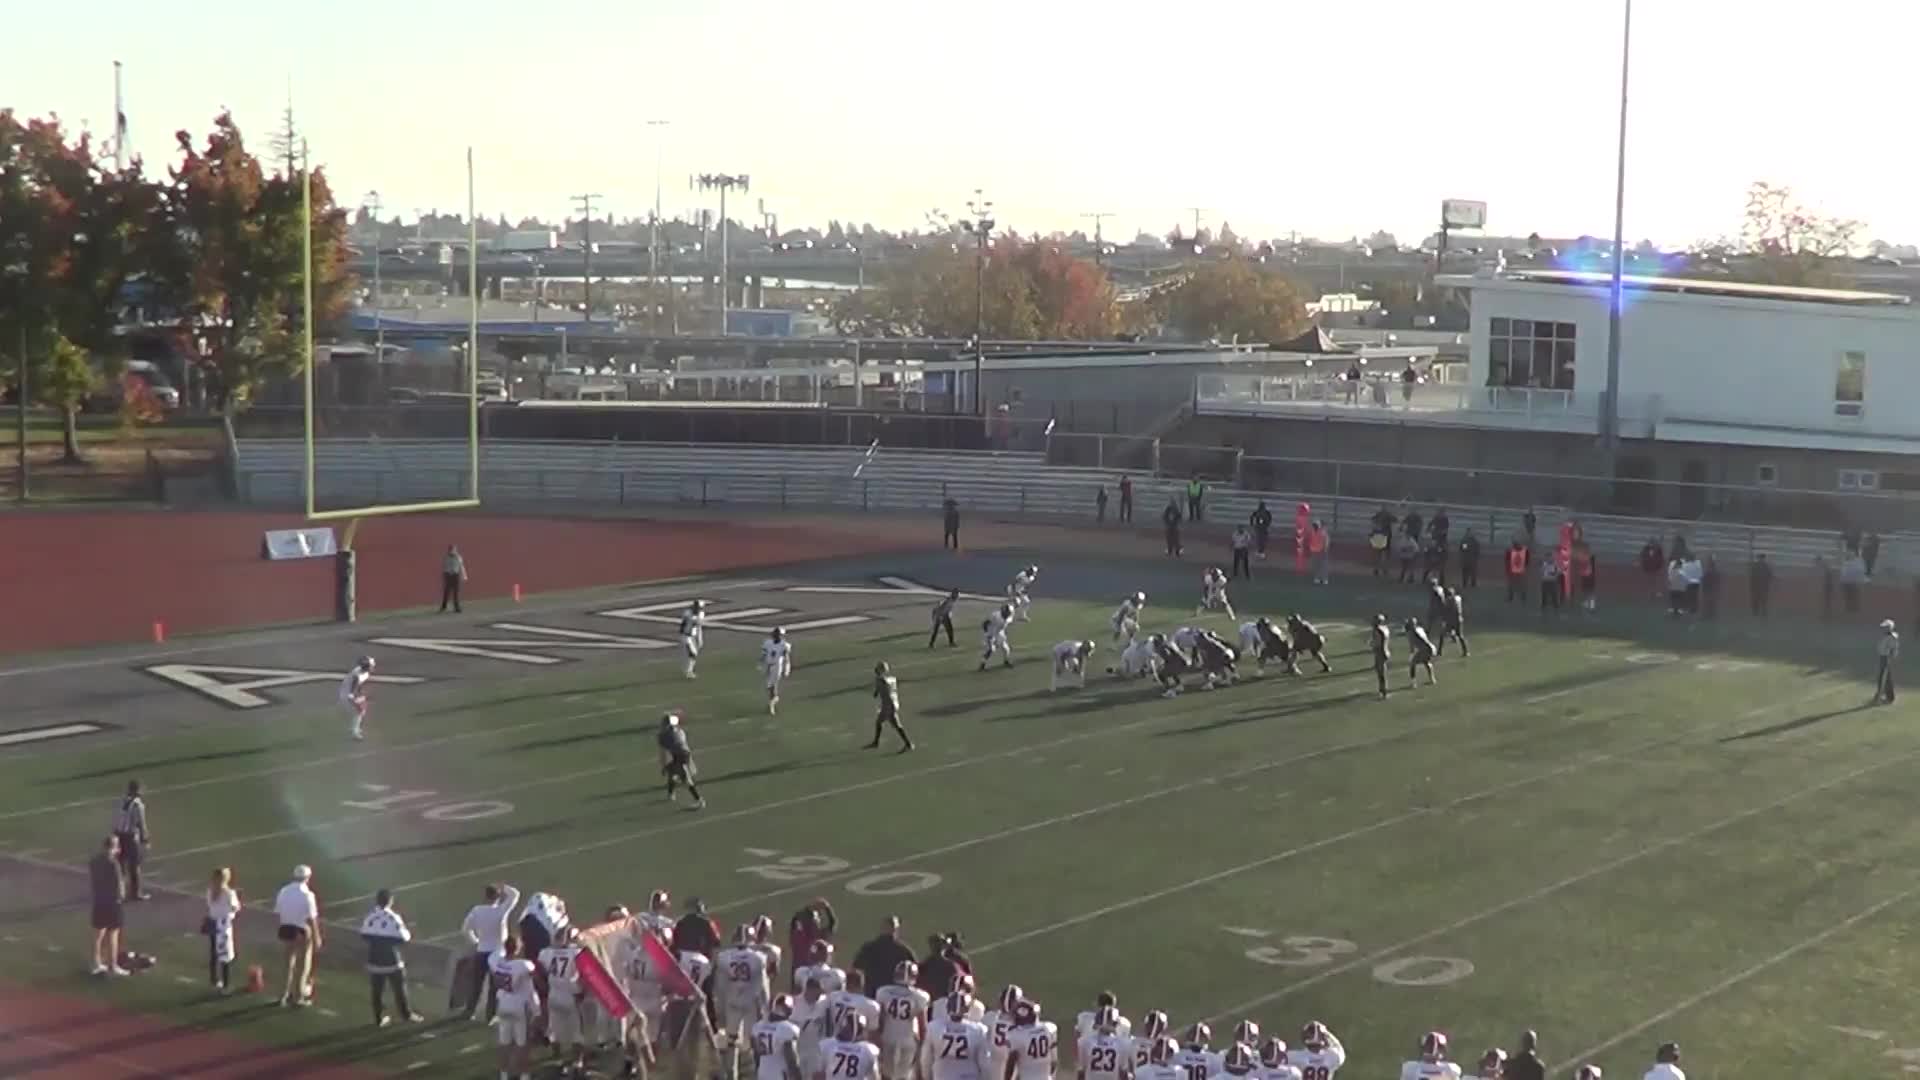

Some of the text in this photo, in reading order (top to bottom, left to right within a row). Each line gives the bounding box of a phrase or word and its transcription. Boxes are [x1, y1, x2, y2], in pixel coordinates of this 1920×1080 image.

[887, 997, 913, 1021] 43
[940, 1034, 969, 1060] 72
[1027, 1035, 1049, 1060] 40
[832, 1053, 861, 1078] 78
[1090, 1047, 1117, 1073] 23
